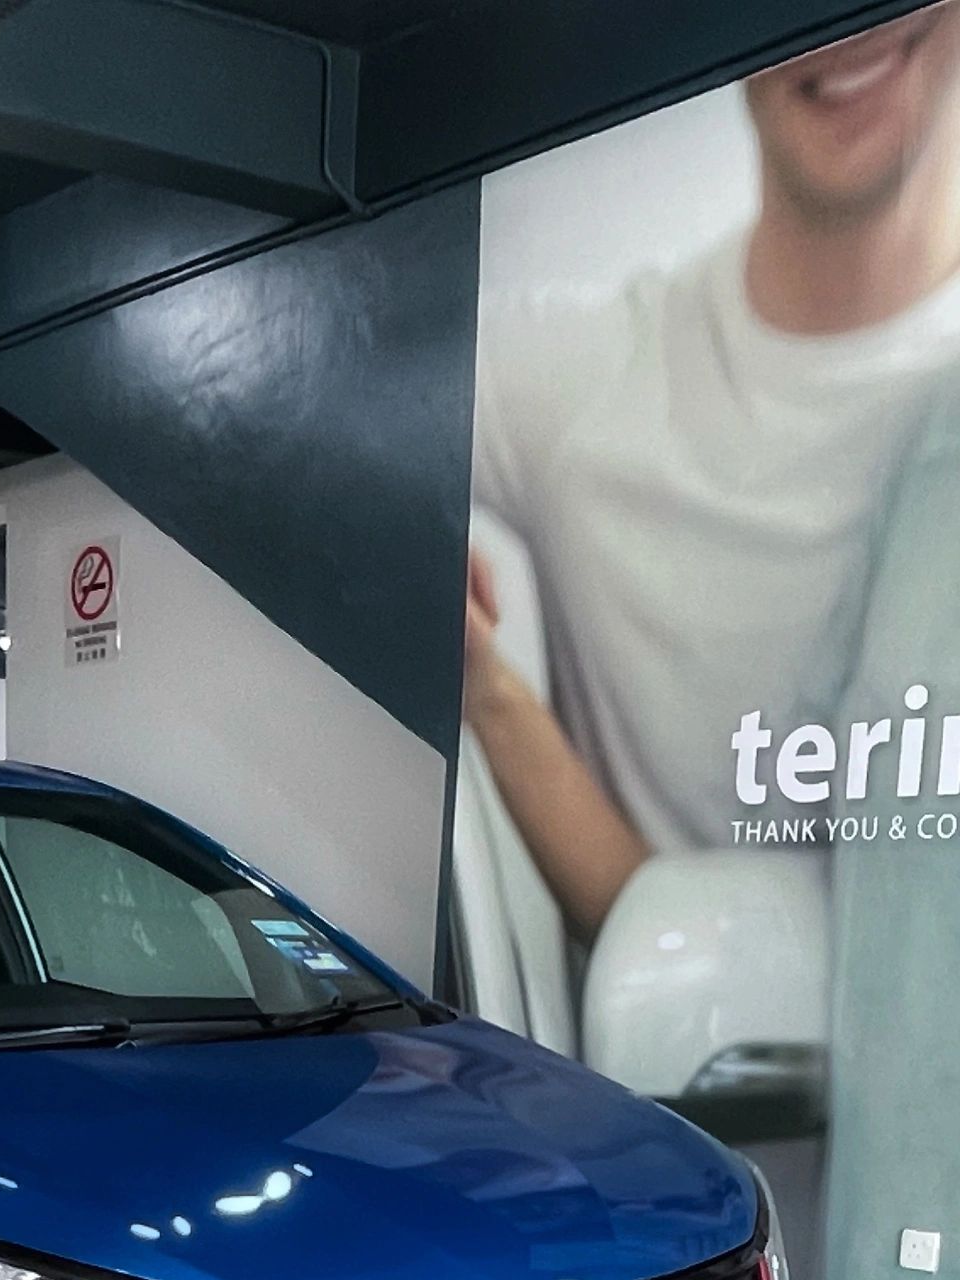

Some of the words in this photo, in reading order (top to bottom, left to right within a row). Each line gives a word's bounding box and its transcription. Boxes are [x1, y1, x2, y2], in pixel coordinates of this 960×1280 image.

[731, 684, 960, 805] teri
[731, 818, 817, 843] THANK
[825, 816, 878, 842] YOU
[888, 814, 907, 840] &
[917, 813, 958, 839] CO
